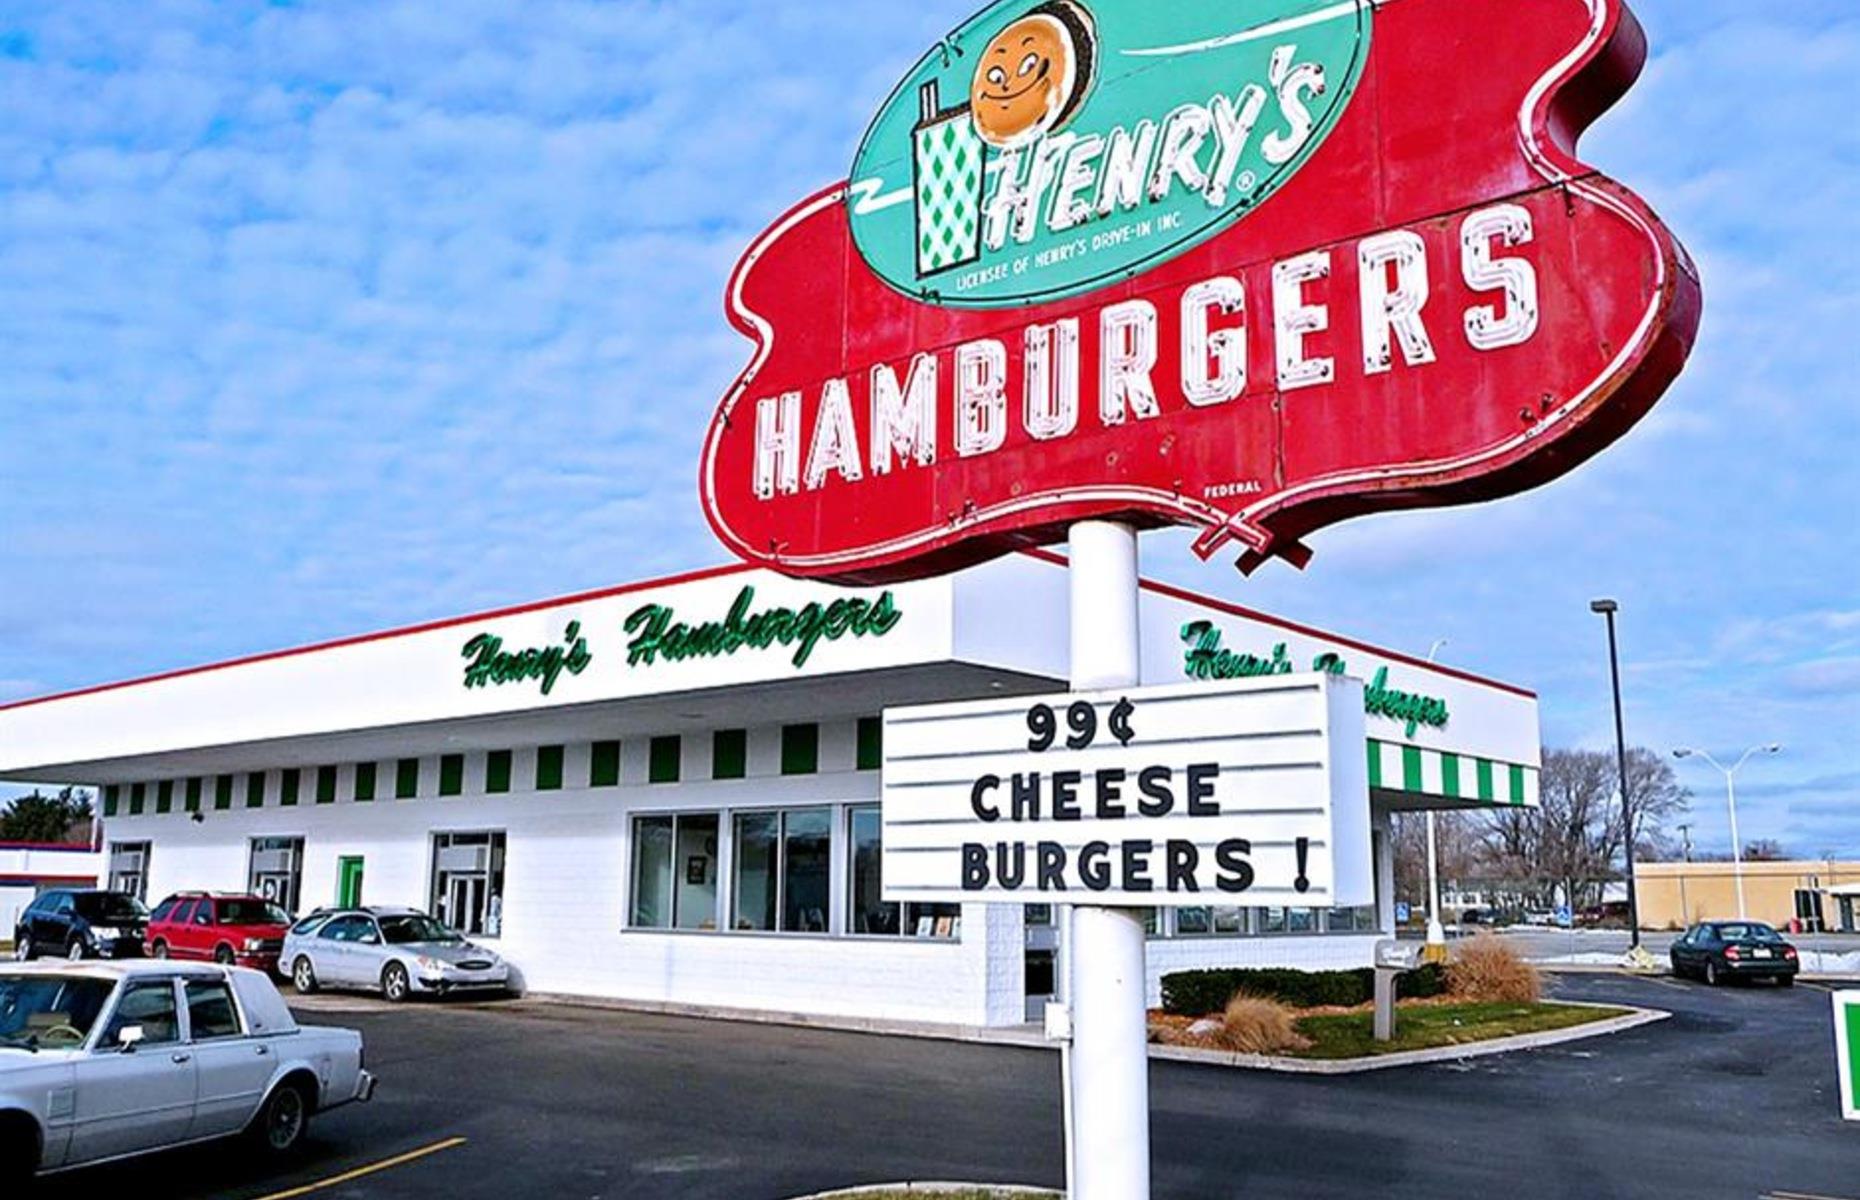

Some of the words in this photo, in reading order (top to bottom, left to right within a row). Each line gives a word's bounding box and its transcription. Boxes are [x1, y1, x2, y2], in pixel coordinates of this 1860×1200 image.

[981, 44, 1326, 250] HENRY'S
[956, 262, 1009, 291] LICENSEE
[1012, 256, 1029, 274] OF
[1034, 237, 1088, 267] HENRY'S
[1091, 222, 1152, 251] DRIVE-IN
[752, 202, 1540, 500] HAMBURGERS
[1203, 480, 1262, 499] FEDERAL
[461, 620, 592, 695] Henry's
[623, 585, 903, 668] Hamburgers
[1026, 696, 1136, 752] 99¢
[970, 762, 1221, 822] CHEESE
[960, 837, 1255, 893] BURGERS
[1293, 837, 1310, 893] !
